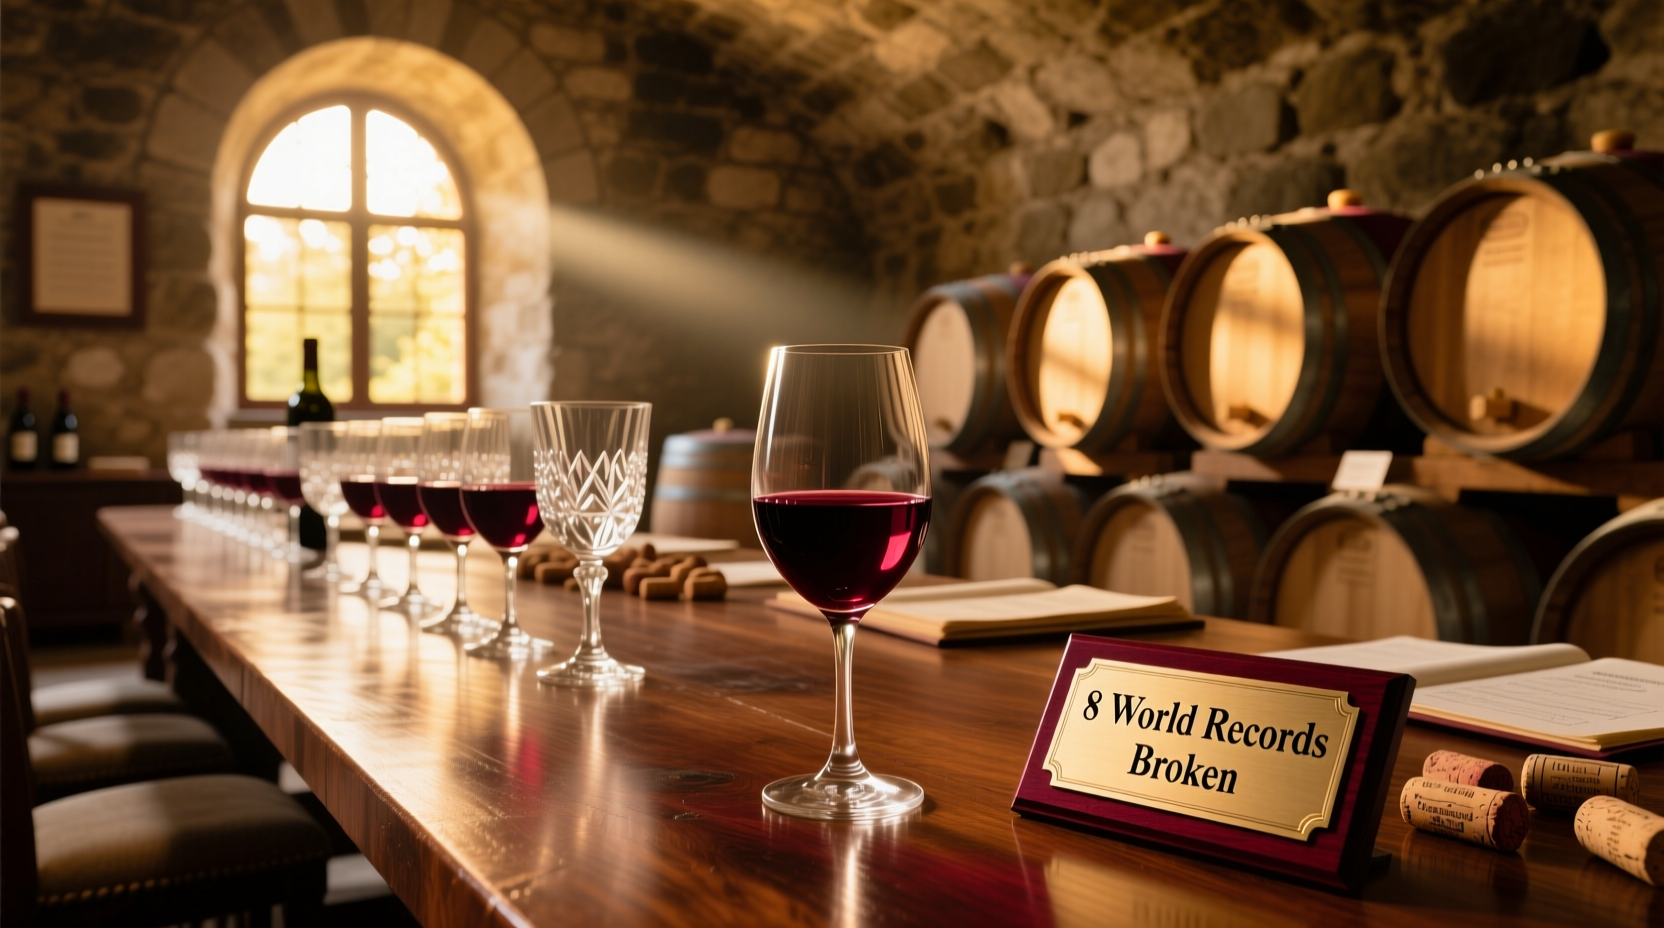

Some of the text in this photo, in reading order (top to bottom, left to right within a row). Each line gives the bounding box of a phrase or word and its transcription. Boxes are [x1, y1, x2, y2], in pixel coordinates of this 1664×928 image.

[1083, 690, 1329, 759] 8 World Records
[1127, 743, 1238, 794] Broken
